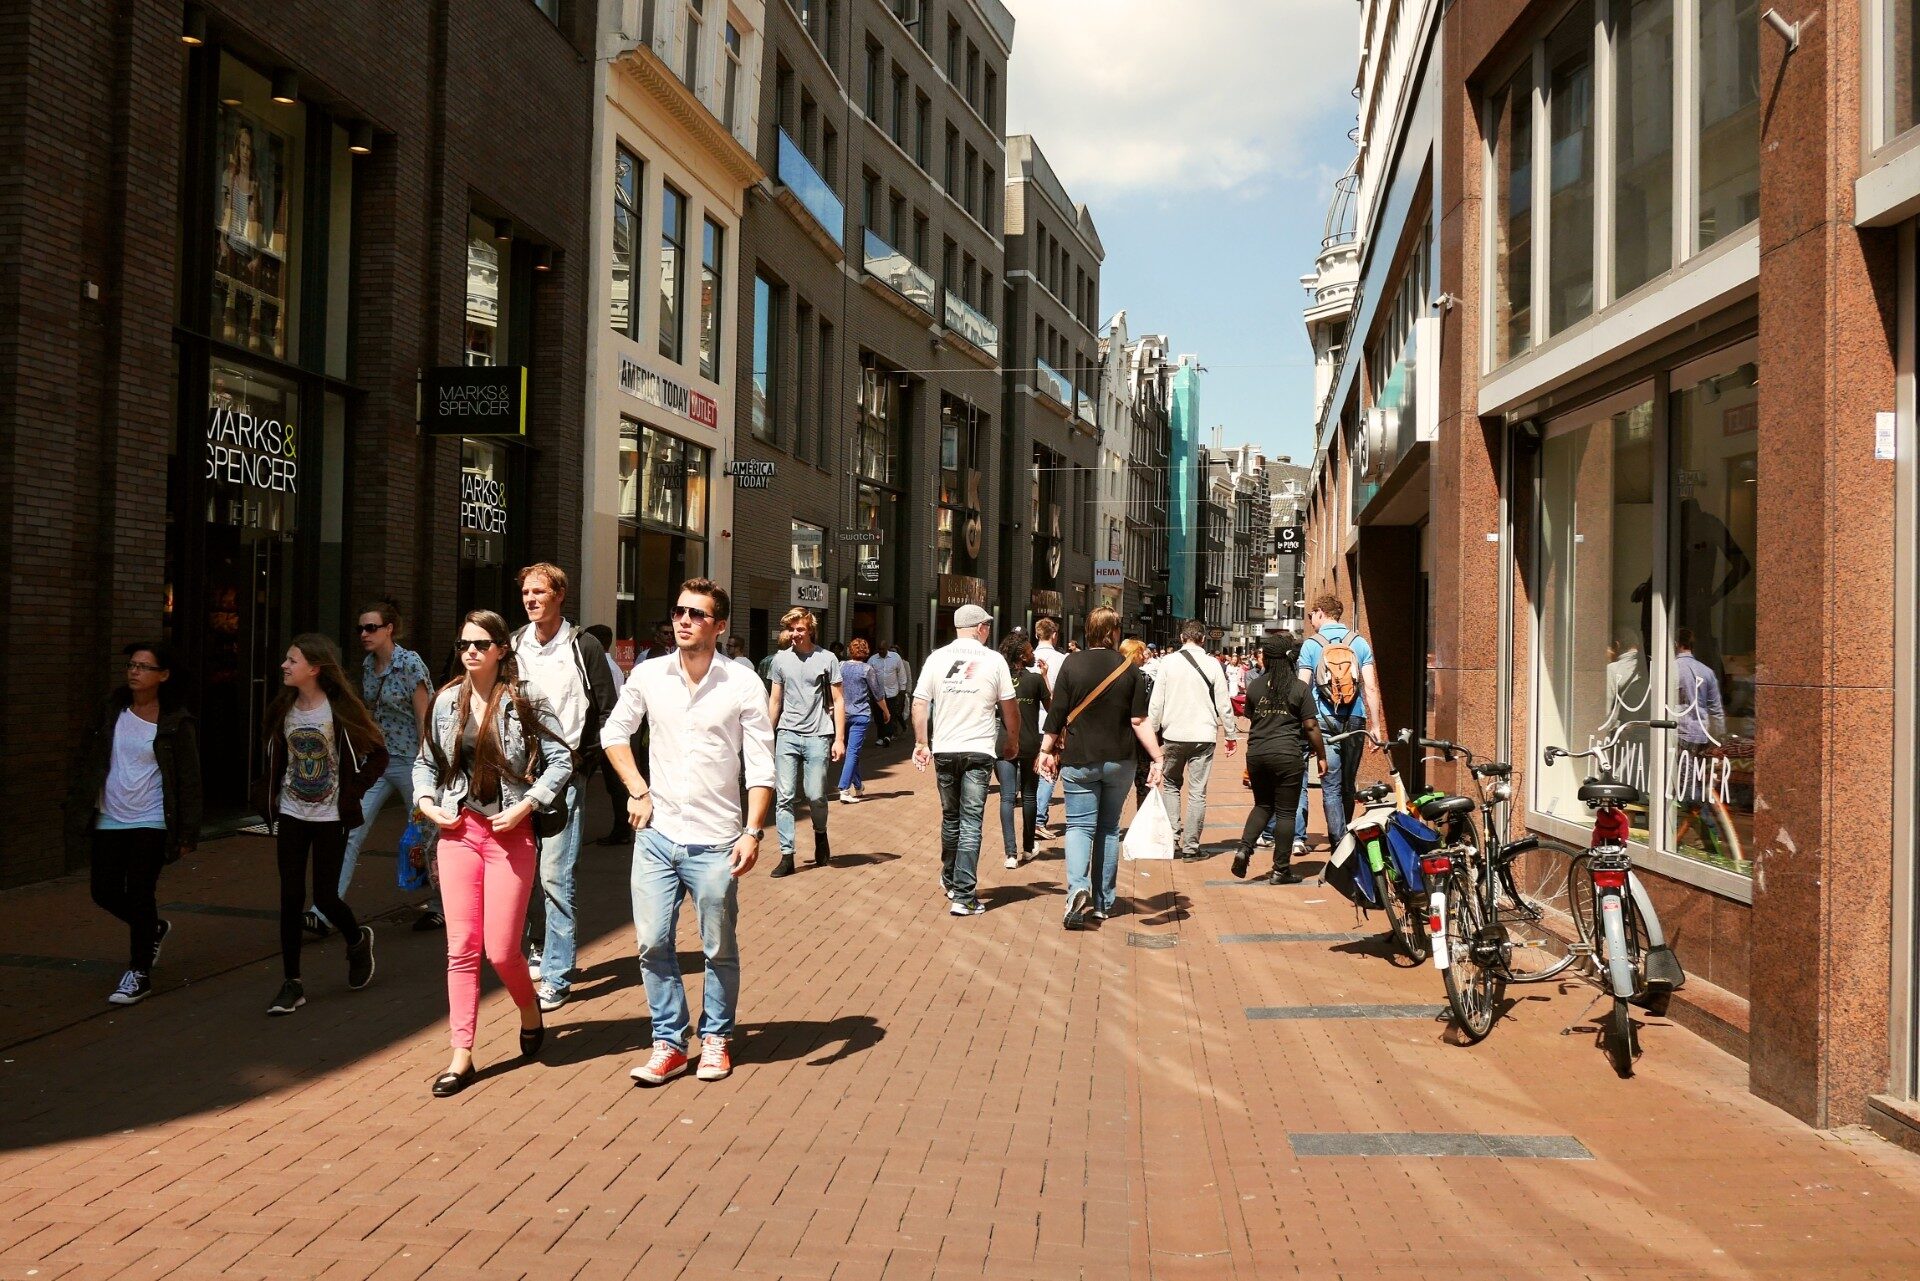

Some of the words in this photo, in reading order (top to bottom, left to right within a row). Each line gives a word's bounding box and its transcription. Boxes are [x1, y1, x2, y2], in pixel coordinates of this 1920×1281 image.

[439, 385, 509, 400] MARKS&
[621, 359, 661, 405] AMERICA
[662, 378, 689, 413] TODAY
[691, 392, 716, 424] OUTLET
[438, 400, 510, 416] SPENCER
[732, 462, 774, 476] AMERICA
[738, 475, 767, 488] TODAY
[460, 501, 507, 535] PENCER
[840, 532, 875, 541] swatch
[1096, 568, 1121, 576] HEMA
[1665, 747, 1730, 804] ZOMER
